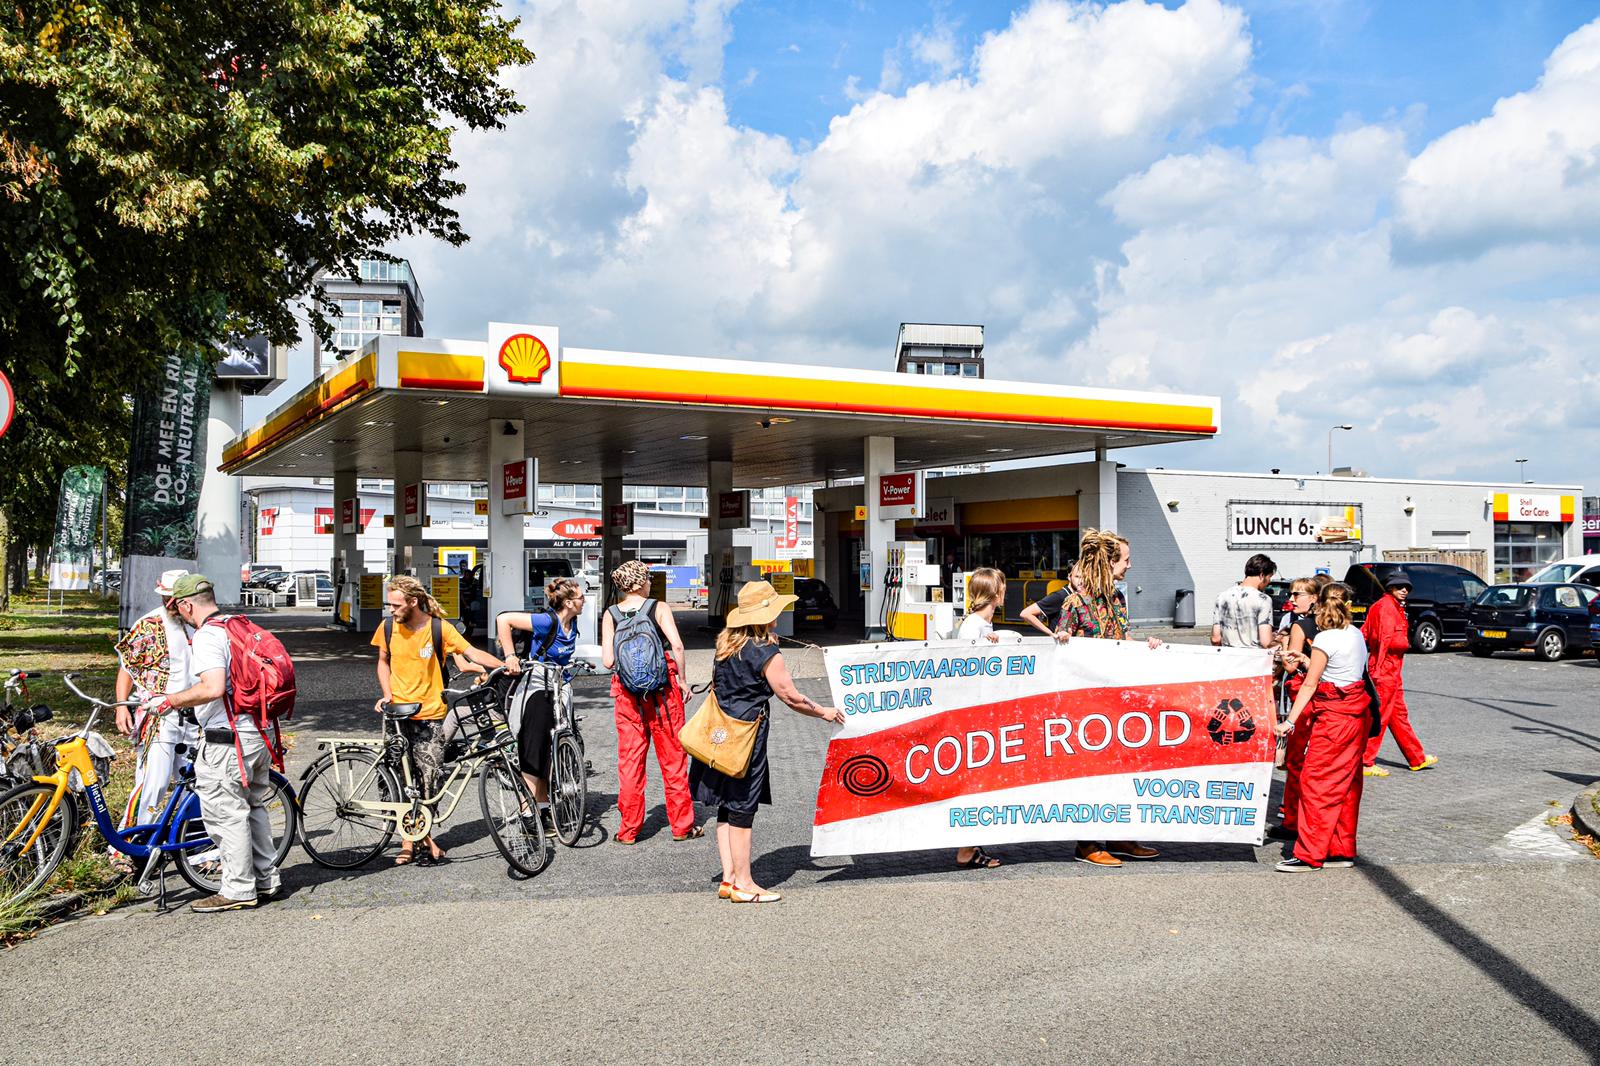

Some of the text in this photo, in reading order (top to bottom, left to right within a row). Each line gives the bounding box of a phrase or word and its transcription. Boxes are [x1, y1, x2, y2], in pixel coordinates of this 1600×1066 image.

[161, 387, 178, 414] EN
[158, 420, 175, 459] MEE
[153, 463, 172, 504] DOE
[883, 485, 911, 495] V-Power
[478, 503, 488, 511] 12
[1520, 498, 1532, 506] Shell
[1520, 507, 1549, 516] Car Care
[788, 504, 798, 540] DAKA
[918, 507, 947, 522] elect
[1236, 517, 1292, 535] LUNCH
[565, 523, 596, 534] DAK
[839, 655, 1036, 686] STRIJDVAARDIG EN
[843, 687, 932, 715] SOLIDAIR
[904, 709, 1192, 785] CODE ROOD
[1132, 778, 1254, 801] VOOR EEN
[949, 803, 1257, 828] RECHTVAARDIGE TRANSITIE
